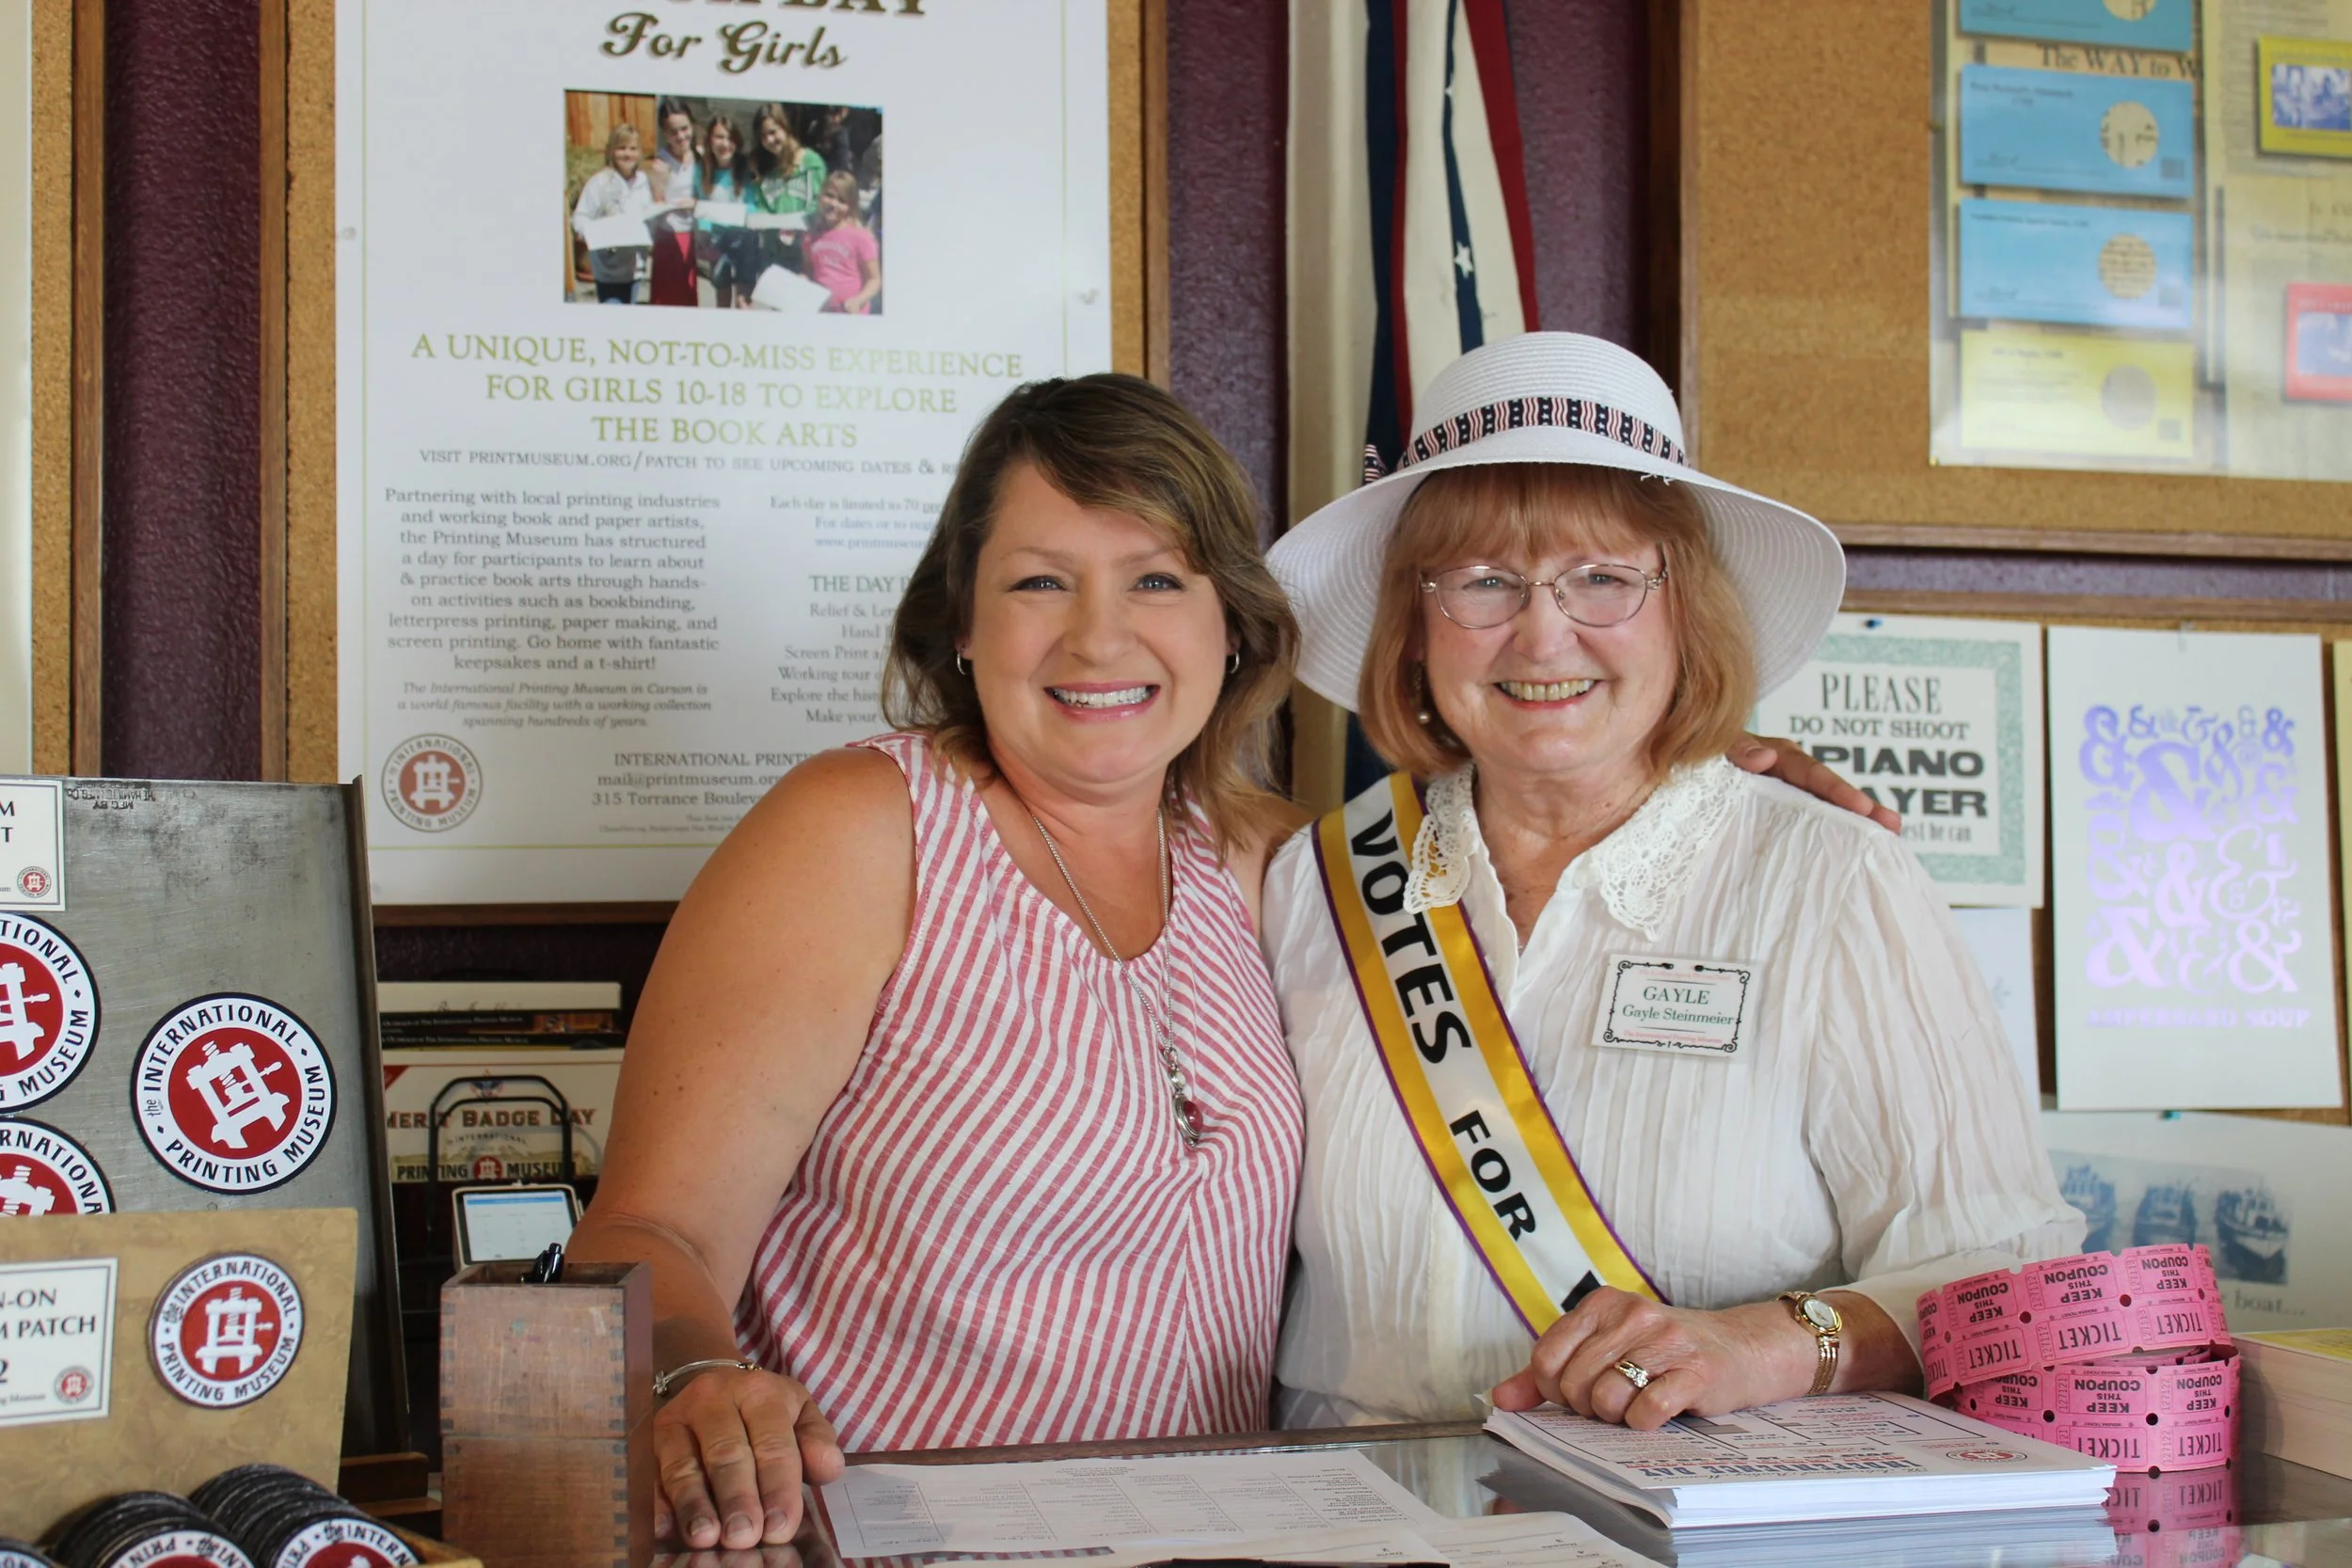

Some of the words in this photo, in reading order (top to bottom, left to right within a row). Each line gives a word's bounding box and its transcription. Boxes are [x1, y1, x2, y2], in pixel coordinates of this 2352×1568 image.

[600, 12, 702, 58] For
[718, 20, 847, 74] Girls
[2082, 48, 2140, 75] WAY
[411, 333, 436, 358] A
[446, 334, 596, 367] UNIQUE,
[608, 339, 816, 372] NOT-TO-MISS
[827, 347, 1023, 378] EXPERIENCE
[485, 373, 554, 401] FOR
[564, 376, 661, 404] GIRLS
[676, 380, 746, 405] 10-18
[757, 382, 803, 408] TO
[815, 385, 957, 413] EXPLORE
[591, 417, 659, 442] THE
[672, 418, 766, 446] BOOK
[775, 421, 857, 448] ARTS
[420, 450, 461, 464] VISIT
[469, 451, 696, 471] PRINTMUSEUM.ORG/PATCH
[706, 456, 724, 468] TO
[732, 457, 762, 470] SEE
[770, 458, 853, 473] UPCOMING
[861, 460, 911, 474] DATES
[918, 459, 934, 474] &
[385, 488, 475, 506] Partnering
[481, 489, 516, 504] with
[522, 490, 560, 505] local
[566, 494, 632, 511] printing
[638, 494, 721, 509] industries
[400, 510, 433, 523] and
[439, 511, 507, 527] working
[513, 511, 552, 526] book
[558, 513, 589, 527] and
[596, 516, 642, 530] paper
[647, 515, 705, 531] artists,
[400, 531, 427, 545] the
[433, 531, 501, 547] Printing
[506, 531, 578, 547] Museum
[584, 533, 613, 547] has
[619, 535, 706, 549] structured
[402, 555, 411, 564] a
[418, 551, 448, 568] day
[453, 551, 477, 565] for
[482, 553, 582, 570] participants
[589, 555, 603, 567] to
[610, 554, 652, 568] learn
[658, 555, 706, 569] about
[400, 572, 414, 586] &
[421, 574, 487, 589] practice
[493, 573, 532, 587] book
[538, 576, 571, 588] arts
[578, 575, 643, 592] through
[649, 575, 706, 590] hands-
[808, 576, 850, 593] THE
[855, 576, 894, 594] DAY
[411, 595, 432, 607] on
[437, 593, 513, 608] activities
[518, 593, 559, 608] such
[564, 597, 582, 609] as
[589, 594, 696, 612] bookbinding,
[389, 612, 478, 630] letterpress
[485, 614, 557, 630] printing,
[563, 617, 610, 632] paper
[614, 616, 681, 633] making,
[686, 616, 718, 630] and
[387, 637, 443, 649] screen
[449, 636, 520, 652] printing.
[527, 635, 550, 649] Go
[557, 636, 602, 649] home
[607, 636, 643, 650] with
[648, 637, 721, 651] fantastic
[454, 656, 541, 673] keepsakes
[547, 657, 578, 670] and
[583, 660, 594, 671] a
[599, 656, 657, 671] t-shirt!
[1821, 673, 1942, 715] PLEASE
[1789, 716, 1823, 735] DO
[1832, 718, 1883, 737] NOT
[1890, 721, 1969, 740] SHOOT
[614, 752, 749, 768] INTERNATIONAL
[1811, 745, 1984, 778] PIANO
[597, 773, 783, 789] mail@printmuseum.or
[592, 792, 622, 806] 315
[628, 792, 699, 806] Torrance
[1644, 986, 1710, 1006] GAYLE
[1350, 807, 1472, 1065] VOTES
[1450, 1110, 1535, 1242] FOR
[1622, 1004, 1661, 1022] Gayle
[1663, 1007, 1734, 1025] Steinmeier
[2245, 1007, 2311, 1029] SOUP
[20, 1009, 89, 1099] MUSEUM
[144, 1004, 298, 1092] INTERNATIONAL
[144, 1099, 165, 1117] the
[282, 1065, 326, 1164] MUSEUM
[462, 1109, 541, 1128] BADGE
[166, 1138, 279, 1184] PRINTING
[506, 1161, 576, 1178] MUSEU
[2141, 1256, 2189, 1270] COUPON
[2043, 1264, 2108, 1285] COUPON
[2068, 1279, 2093, 1291] THIS
[2156, 1278, 2187, 1290] KEEP
[175, 1260, 297, 1317] INTERNATIONAL
[1958, 1282, 2009, 1305] COUPON
[2060, 1288, 2103, 1304] KEEP
[1974, 1298, 1994, 1309] THIS
[1970, 1306, 2004, 1323] KEEP
[2156, 1312, 2203, 1336] TICKET
[18, 1315, 97, 1339] PATCH
[2058, 1321, 2122, 1350] TICKET
[2037, 1325, 2054, 1359] 127112
[1968, 1338, 2022, 1369] TICKET
[161, 1341, 224, 1402] PRINTING
[234, 1336, 295, 1399] MUSEUM
[1990, 1374, 2038, 1387] COUP
[2001, 1386, 2023, 1395] THIS
[2074, 1379, 2141, 1392] COUPON
[2177, 1374, 2222, 1389] COUPON
[1994, 1394, 2028, 1408] KEEP
[2058, 1377, 2069, 1411] 127121
[2195, 1389, 2212, 1398] THIS
[2087, 1402, 2130, 1413] KEEP
[2186, 1398, 2217, 1411] KEEP
[2077, 1437, 2140, 1459] TICKET
[2178, 1433, 2223, 1457] TICKET
[1640, 1465, 1695, 1478] DAY
[1708, 1459, 1923, 1474] INDEPENDENCE
